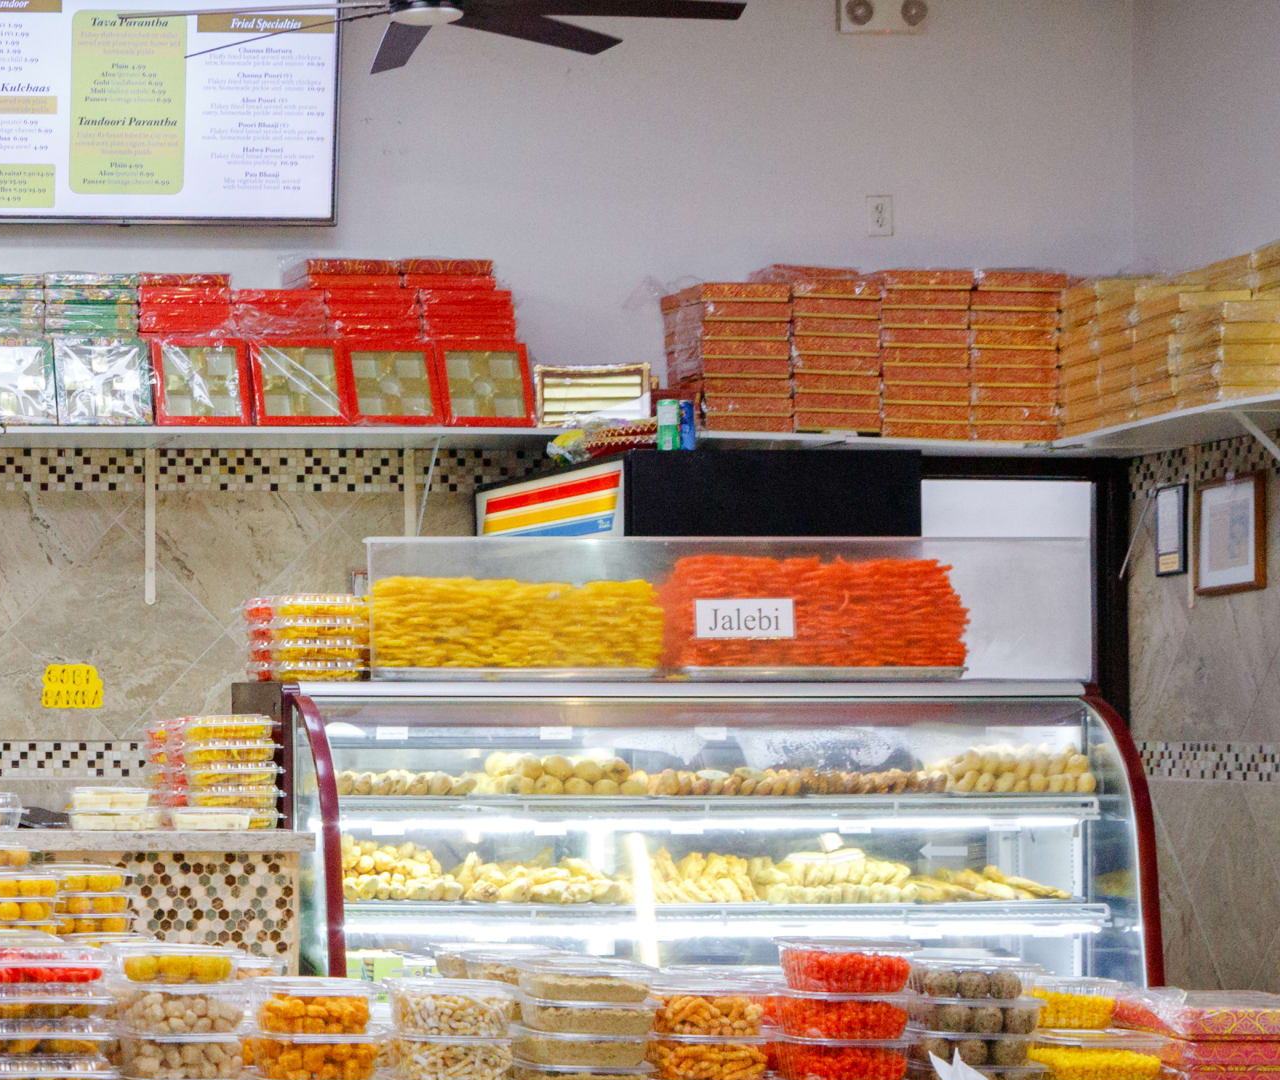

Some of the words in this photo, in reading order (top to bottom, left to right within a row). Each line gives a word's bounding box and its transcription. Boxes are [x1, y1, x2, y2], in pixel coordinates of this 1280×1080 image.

[91, 17, 116, 27] Tava
[120, 17, 168, 27] Parantha
[230, 18, 255, 29] Fried
[256, 18, 302, 31] Specialties
[1, 83, 50, 92] Kulchaas
[79, 117, 127, 126] Tandoori
[129, 117, 177, 126] Parantha
[709, 608, 781, 631] Jalebi
[46, 669, 91, 684] GOBI
